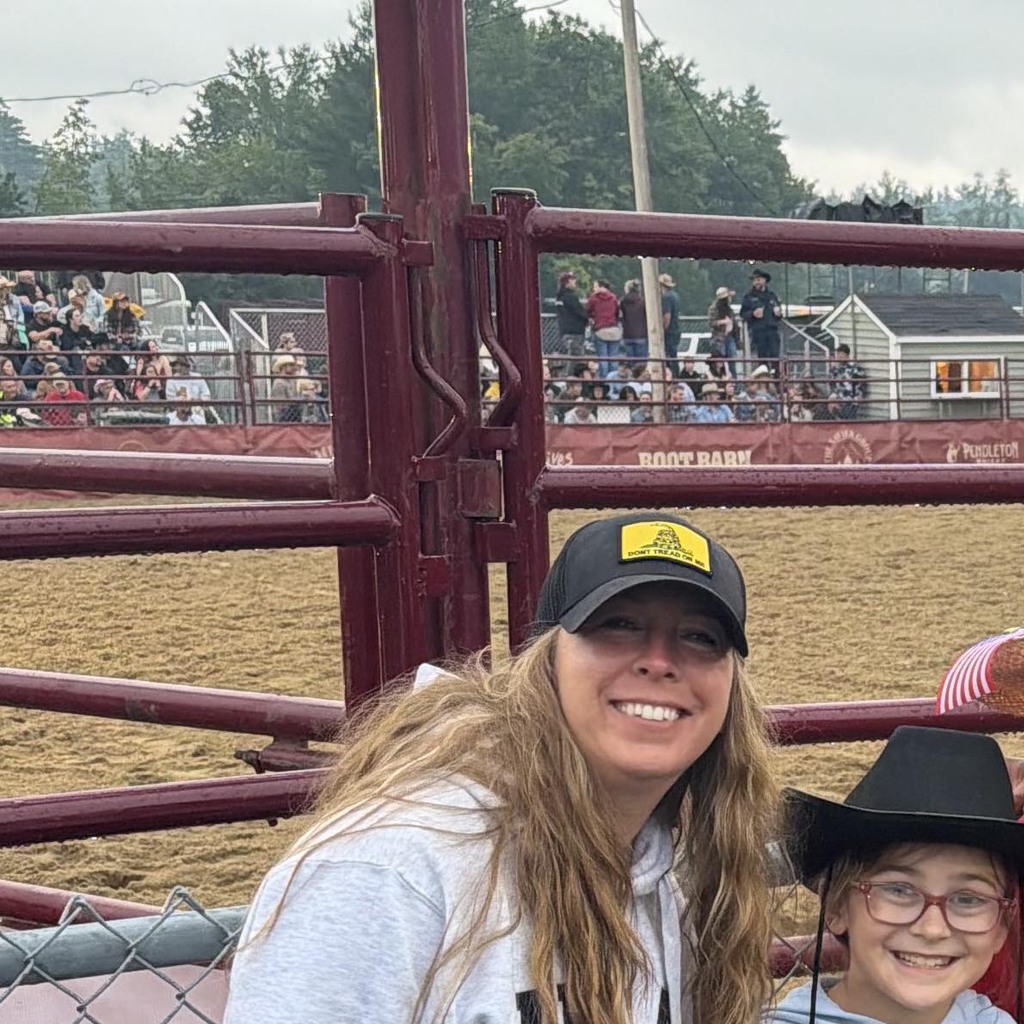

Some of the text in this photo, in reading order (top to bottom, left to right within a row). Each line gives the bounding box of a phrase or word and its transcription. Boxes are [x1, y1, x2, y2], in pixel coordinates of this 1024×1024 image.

[638, 450, 752, 466] BOOT BARN
[962, 441, 1019, 459] PENDLETON
[653, 549, 681, 557] TREAD
